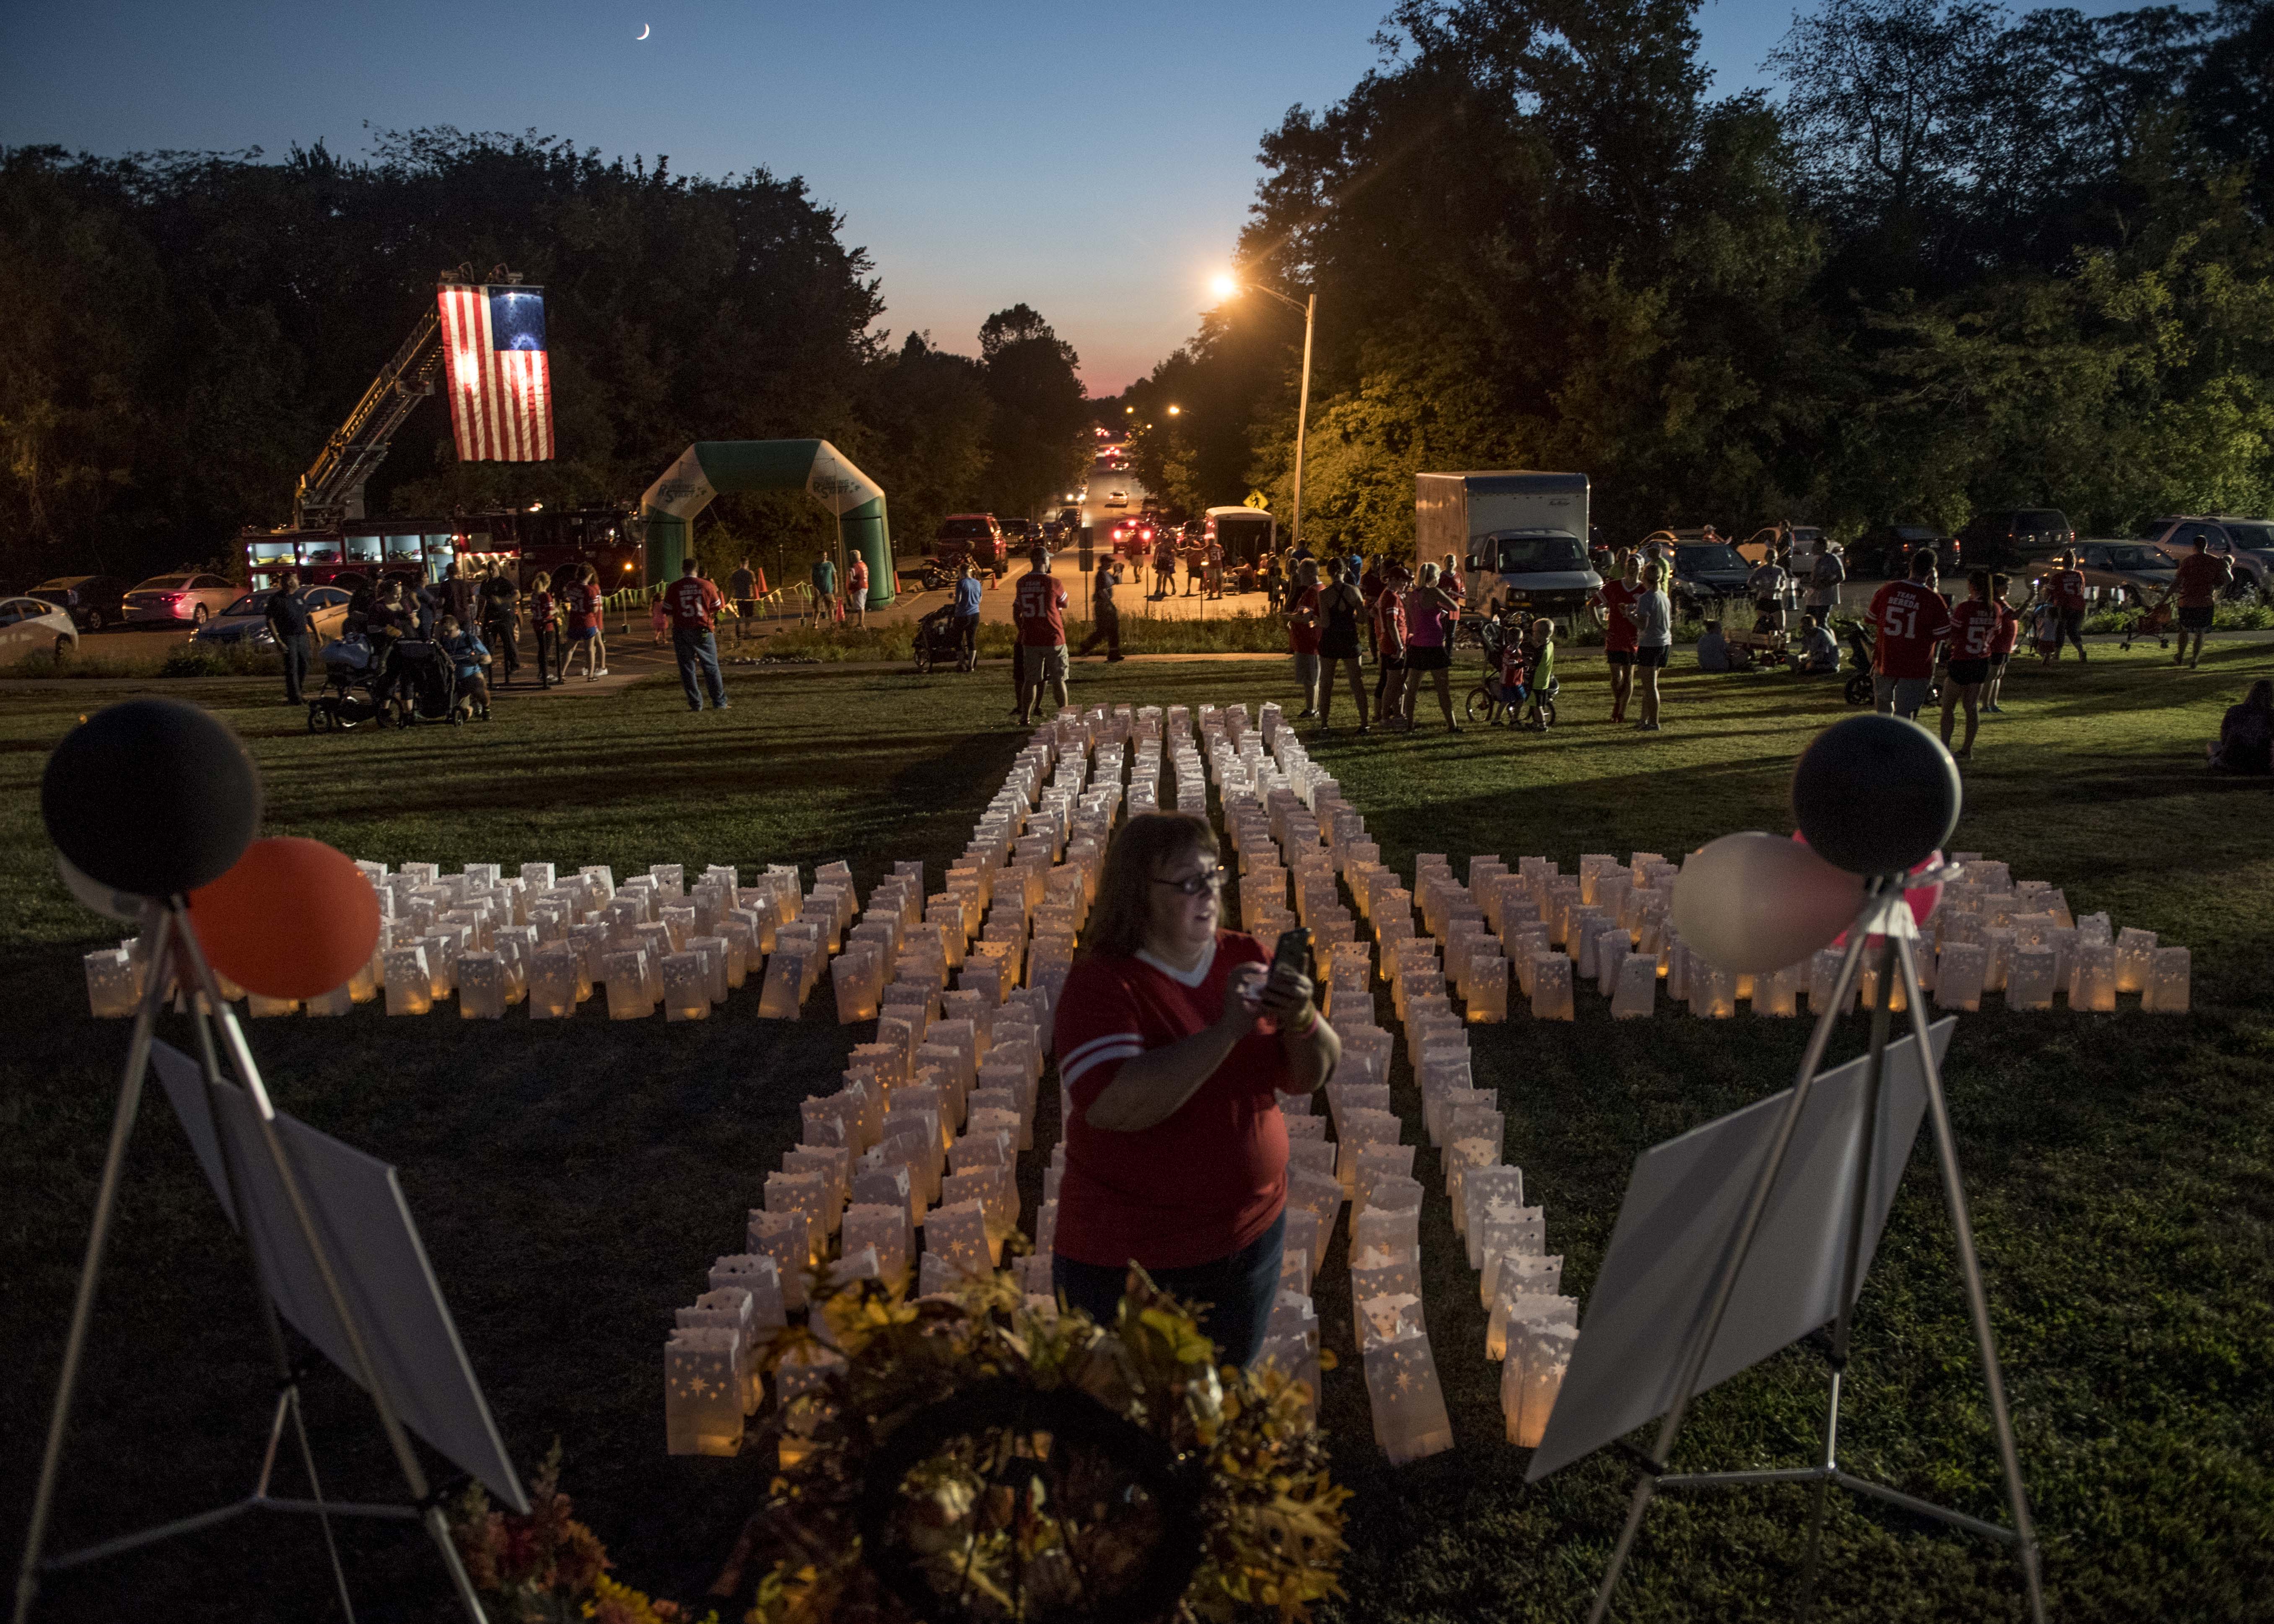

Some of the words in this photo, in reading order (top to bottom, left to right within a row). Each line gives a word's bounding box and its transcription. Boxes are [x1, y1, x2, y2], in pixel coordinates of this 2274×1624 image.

[1210, 552, 1221, 560] 51
[1888, 597, 1920, 610] BEREDA
[1897, 591, 1917, 601] TEAM
[680, 596, 704, 617] 51
[1021, 594, 1046, 617] 51
[1884, 605, 1917, 639] 51
